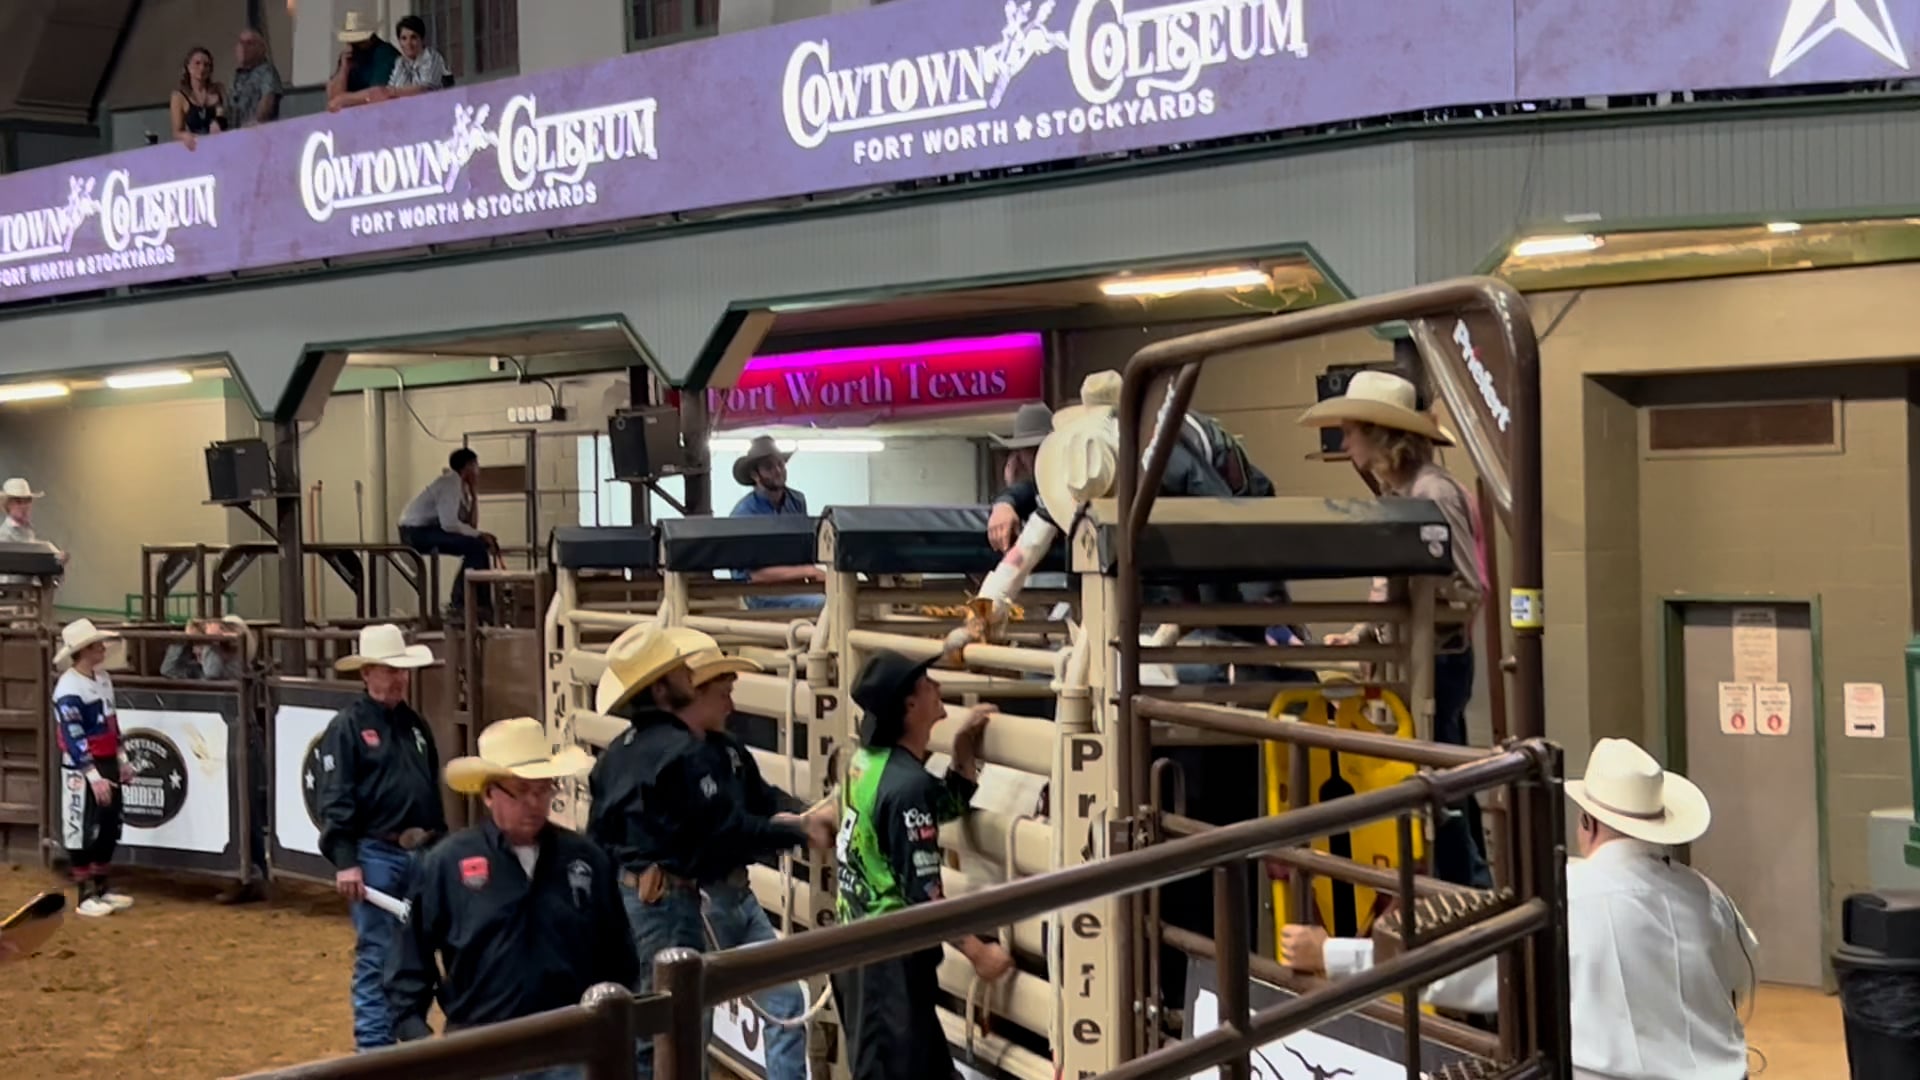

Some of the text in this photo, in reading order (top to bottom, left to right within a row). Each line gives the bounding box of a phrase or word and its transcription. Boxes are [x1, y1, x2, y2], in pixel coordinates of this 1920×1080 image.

[783, 0, 1308, 148] COWTOWN COLISEUM
[301, 93, 658, 222] COWTOWN COLISEUM
[854, 88, 1215, 164] FORT WORTH STOCKYARDS
[0, 168, 218, 259] TOWN COLISEUM
[351, 181, 598, 236] FORT WORTH STOCKYARDS
[30, 259, 75, 283] WORTH
[87, 244, 176, 275] STOCKYARDS
[784, 370, 893, 407] Worth
[902, 361, 1007, 400] Texas
